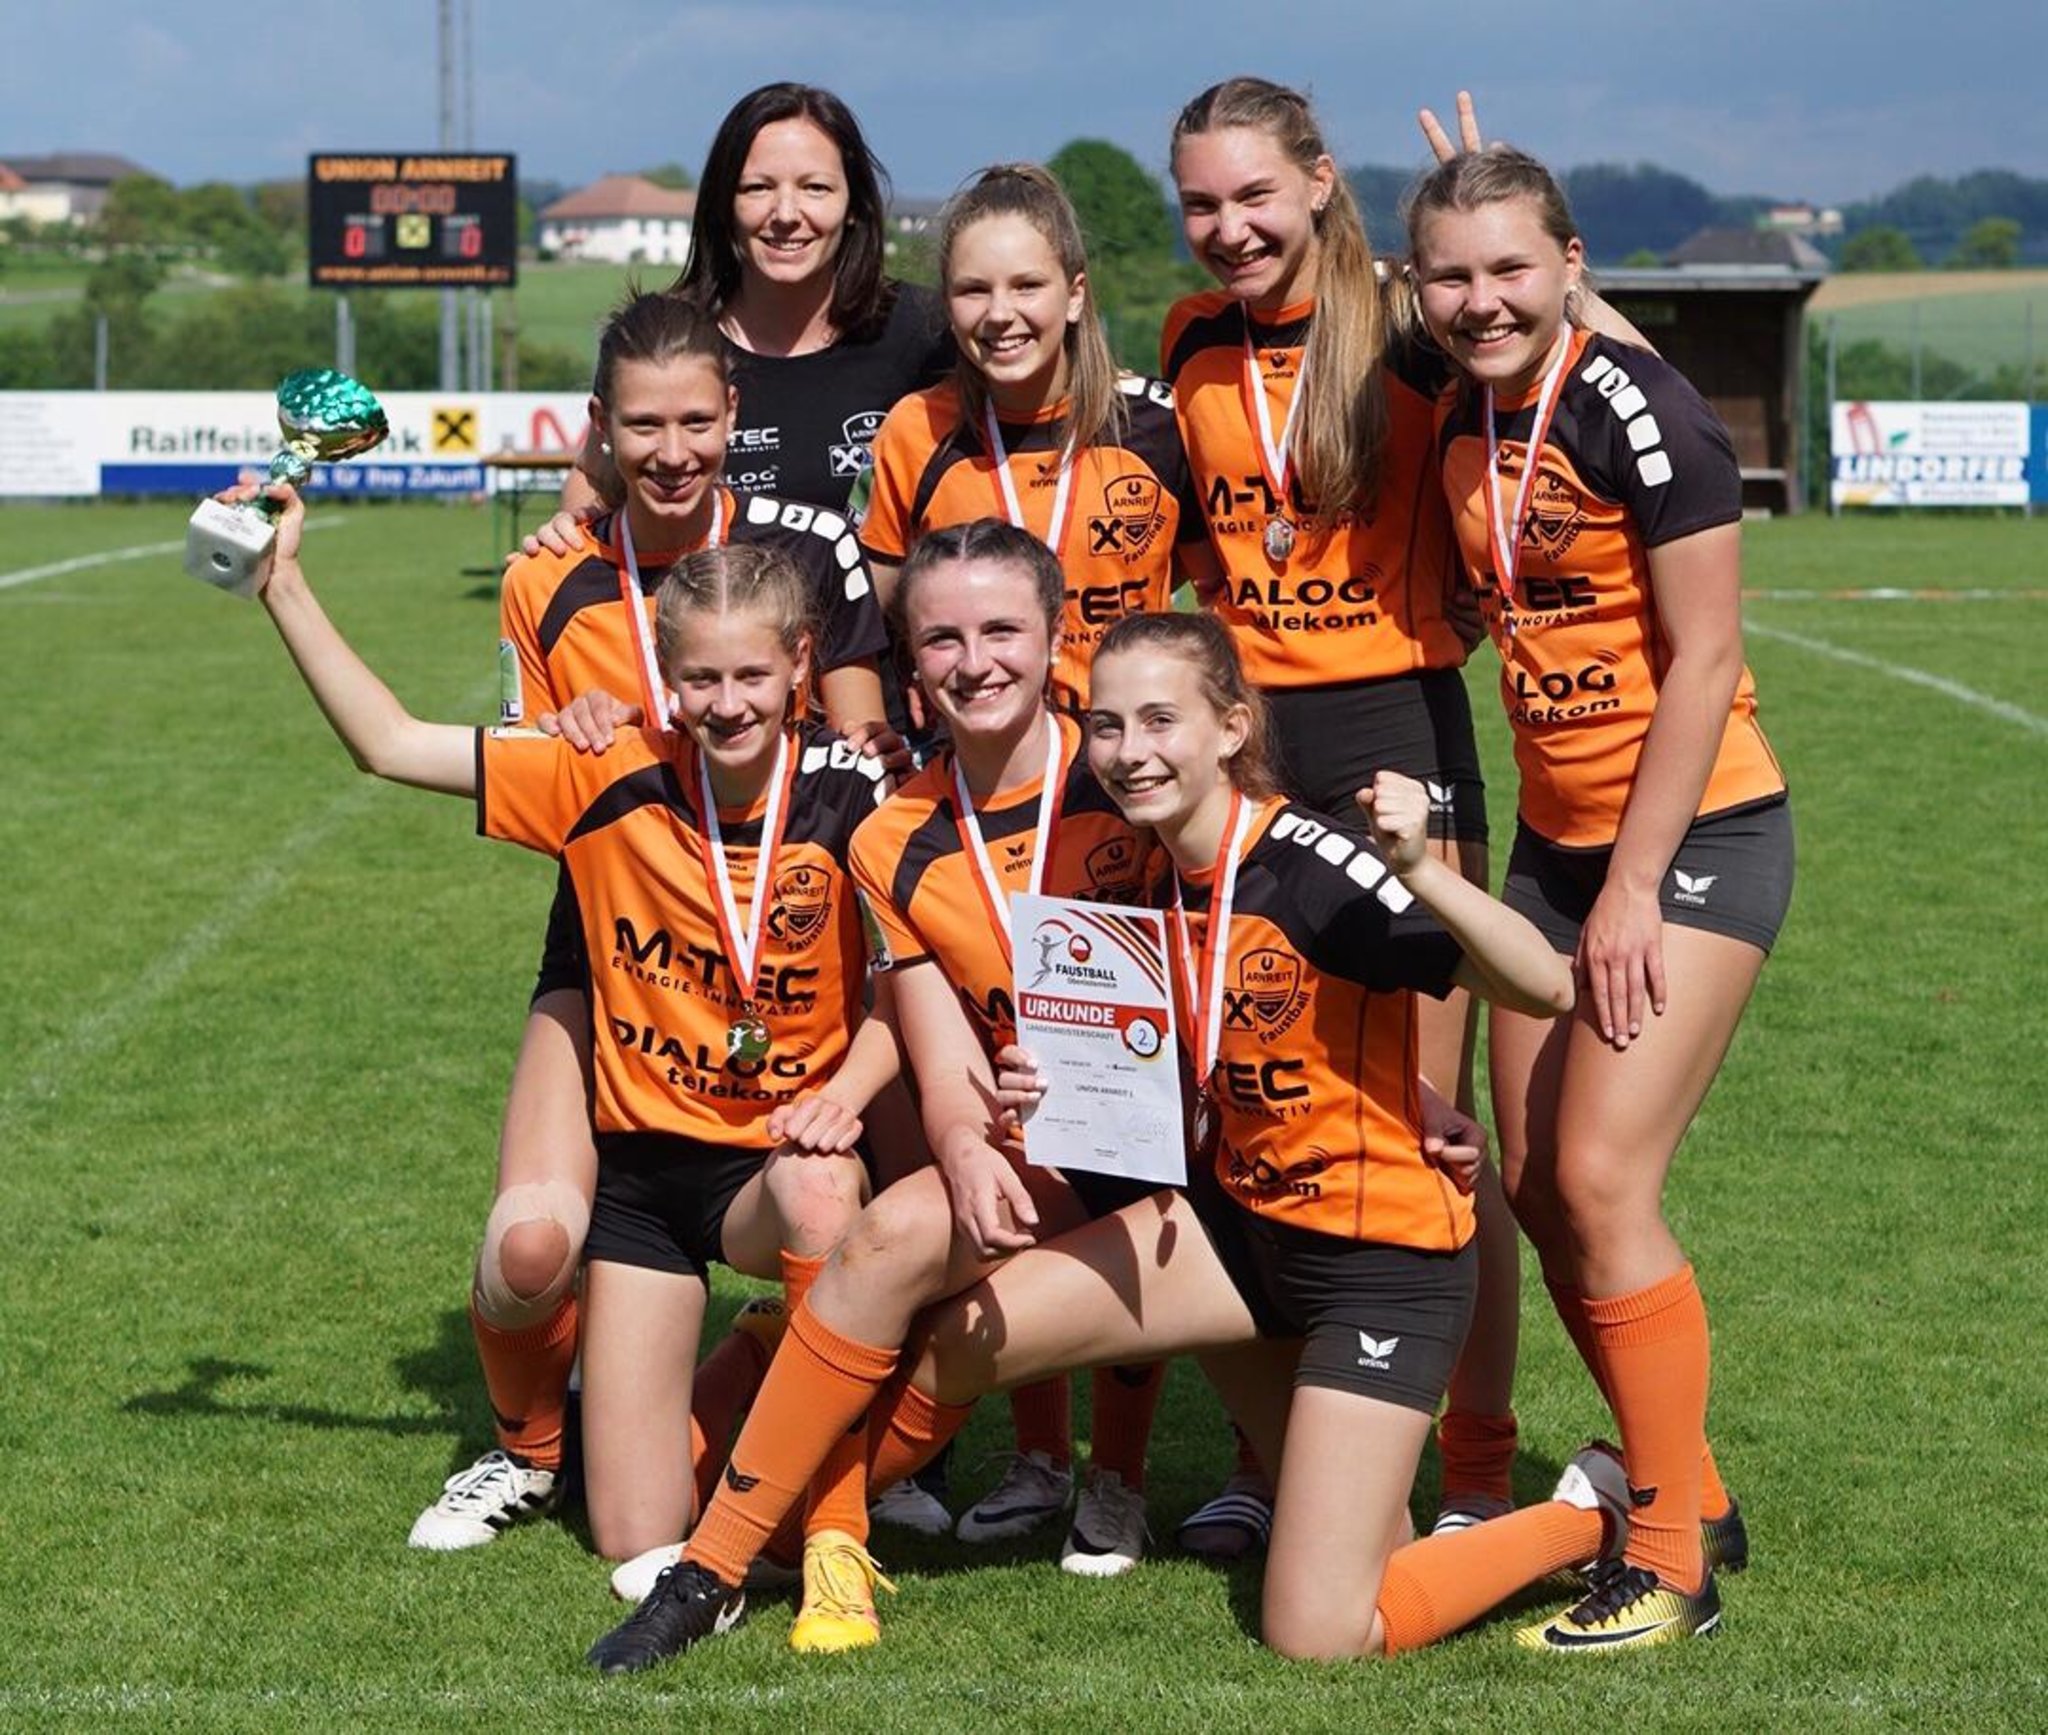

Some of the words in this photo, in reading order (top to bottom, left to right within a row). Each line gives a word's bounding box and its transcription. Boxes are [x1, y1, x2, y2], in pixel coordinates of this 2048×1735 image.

[315, 157, 397, 182] UNION
[400, 158, 507, 181] ARNREIT
[729, 427, 779, 446] TEC
[727, 470, 775, 485] LOG
[1516, 664, 1616, 701] LOG
[1055, 963, 1117, 981] FAUSTBALL
[1025, 997, 1116, 1026] URKUNDE
[1259, 991, 1311, 1045] Faustball
